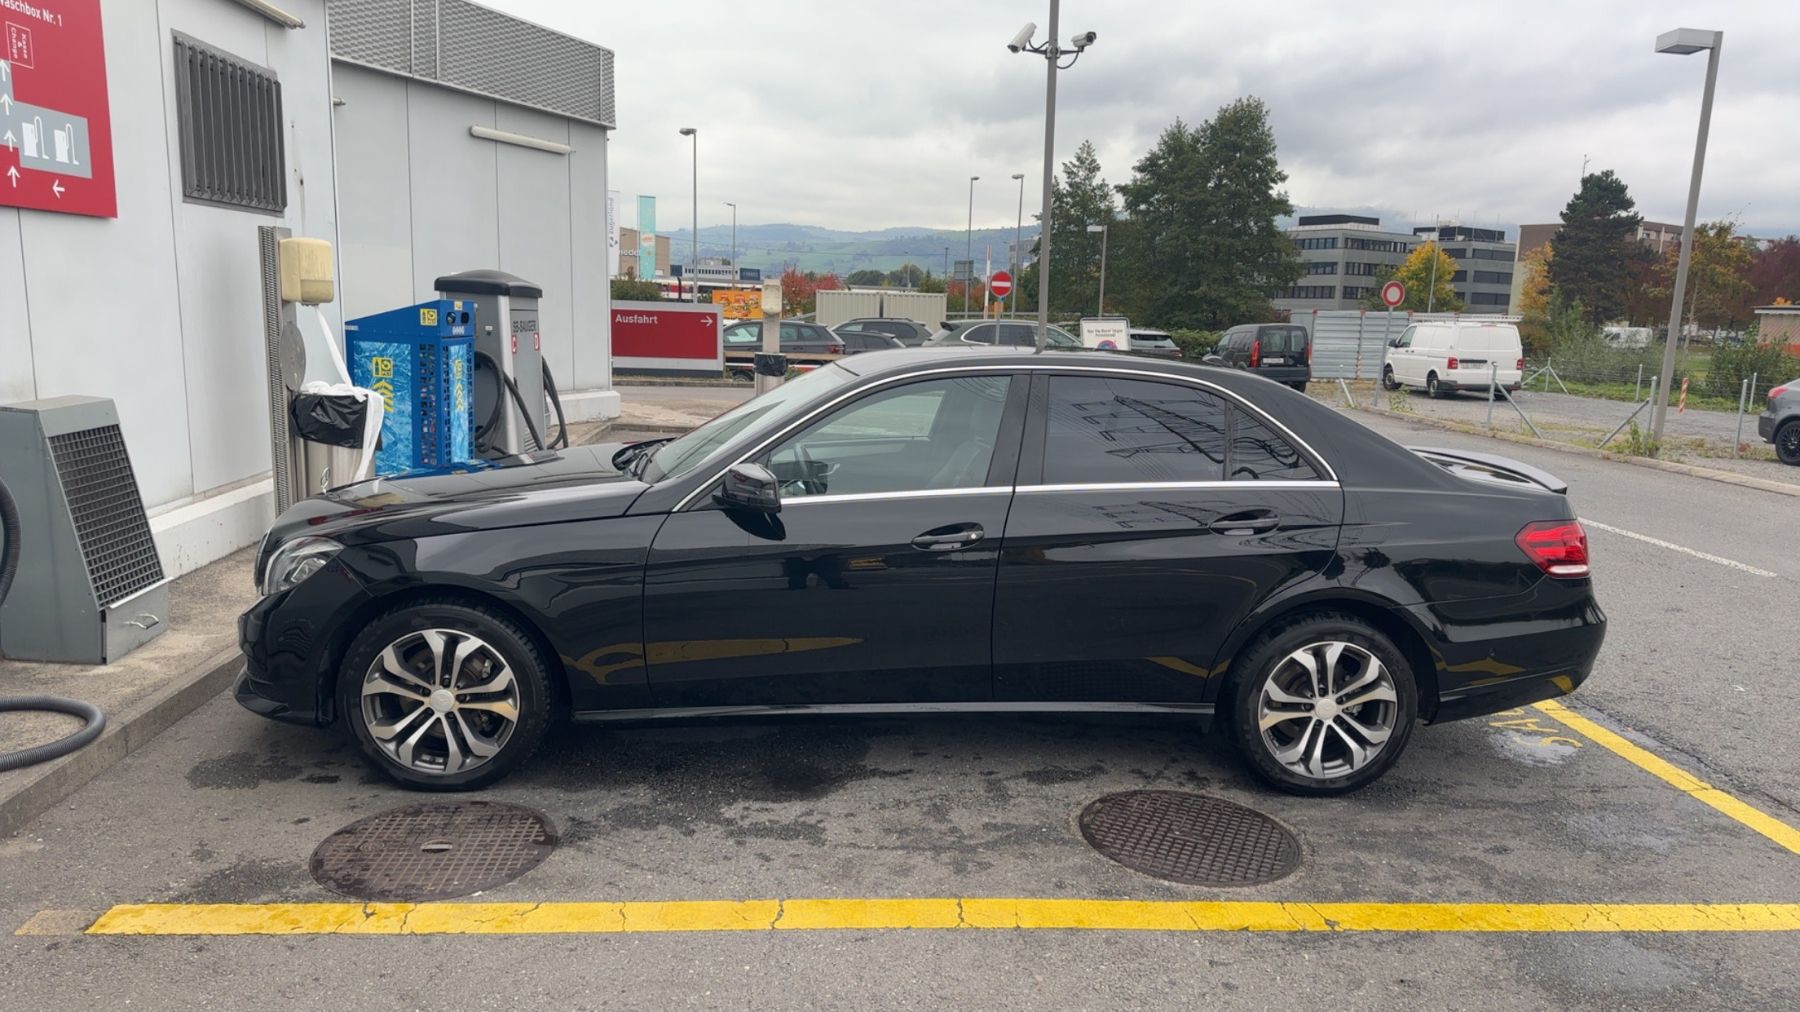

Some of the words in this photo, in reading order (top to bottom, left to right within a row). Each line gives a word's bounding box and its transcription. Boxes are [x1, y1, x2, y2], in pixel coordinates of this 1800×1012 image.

[42, 8, 56, 24] Nr.
[57, 14, 62, 27] 1
[615, 314, 658, 324] Ausfahrt
